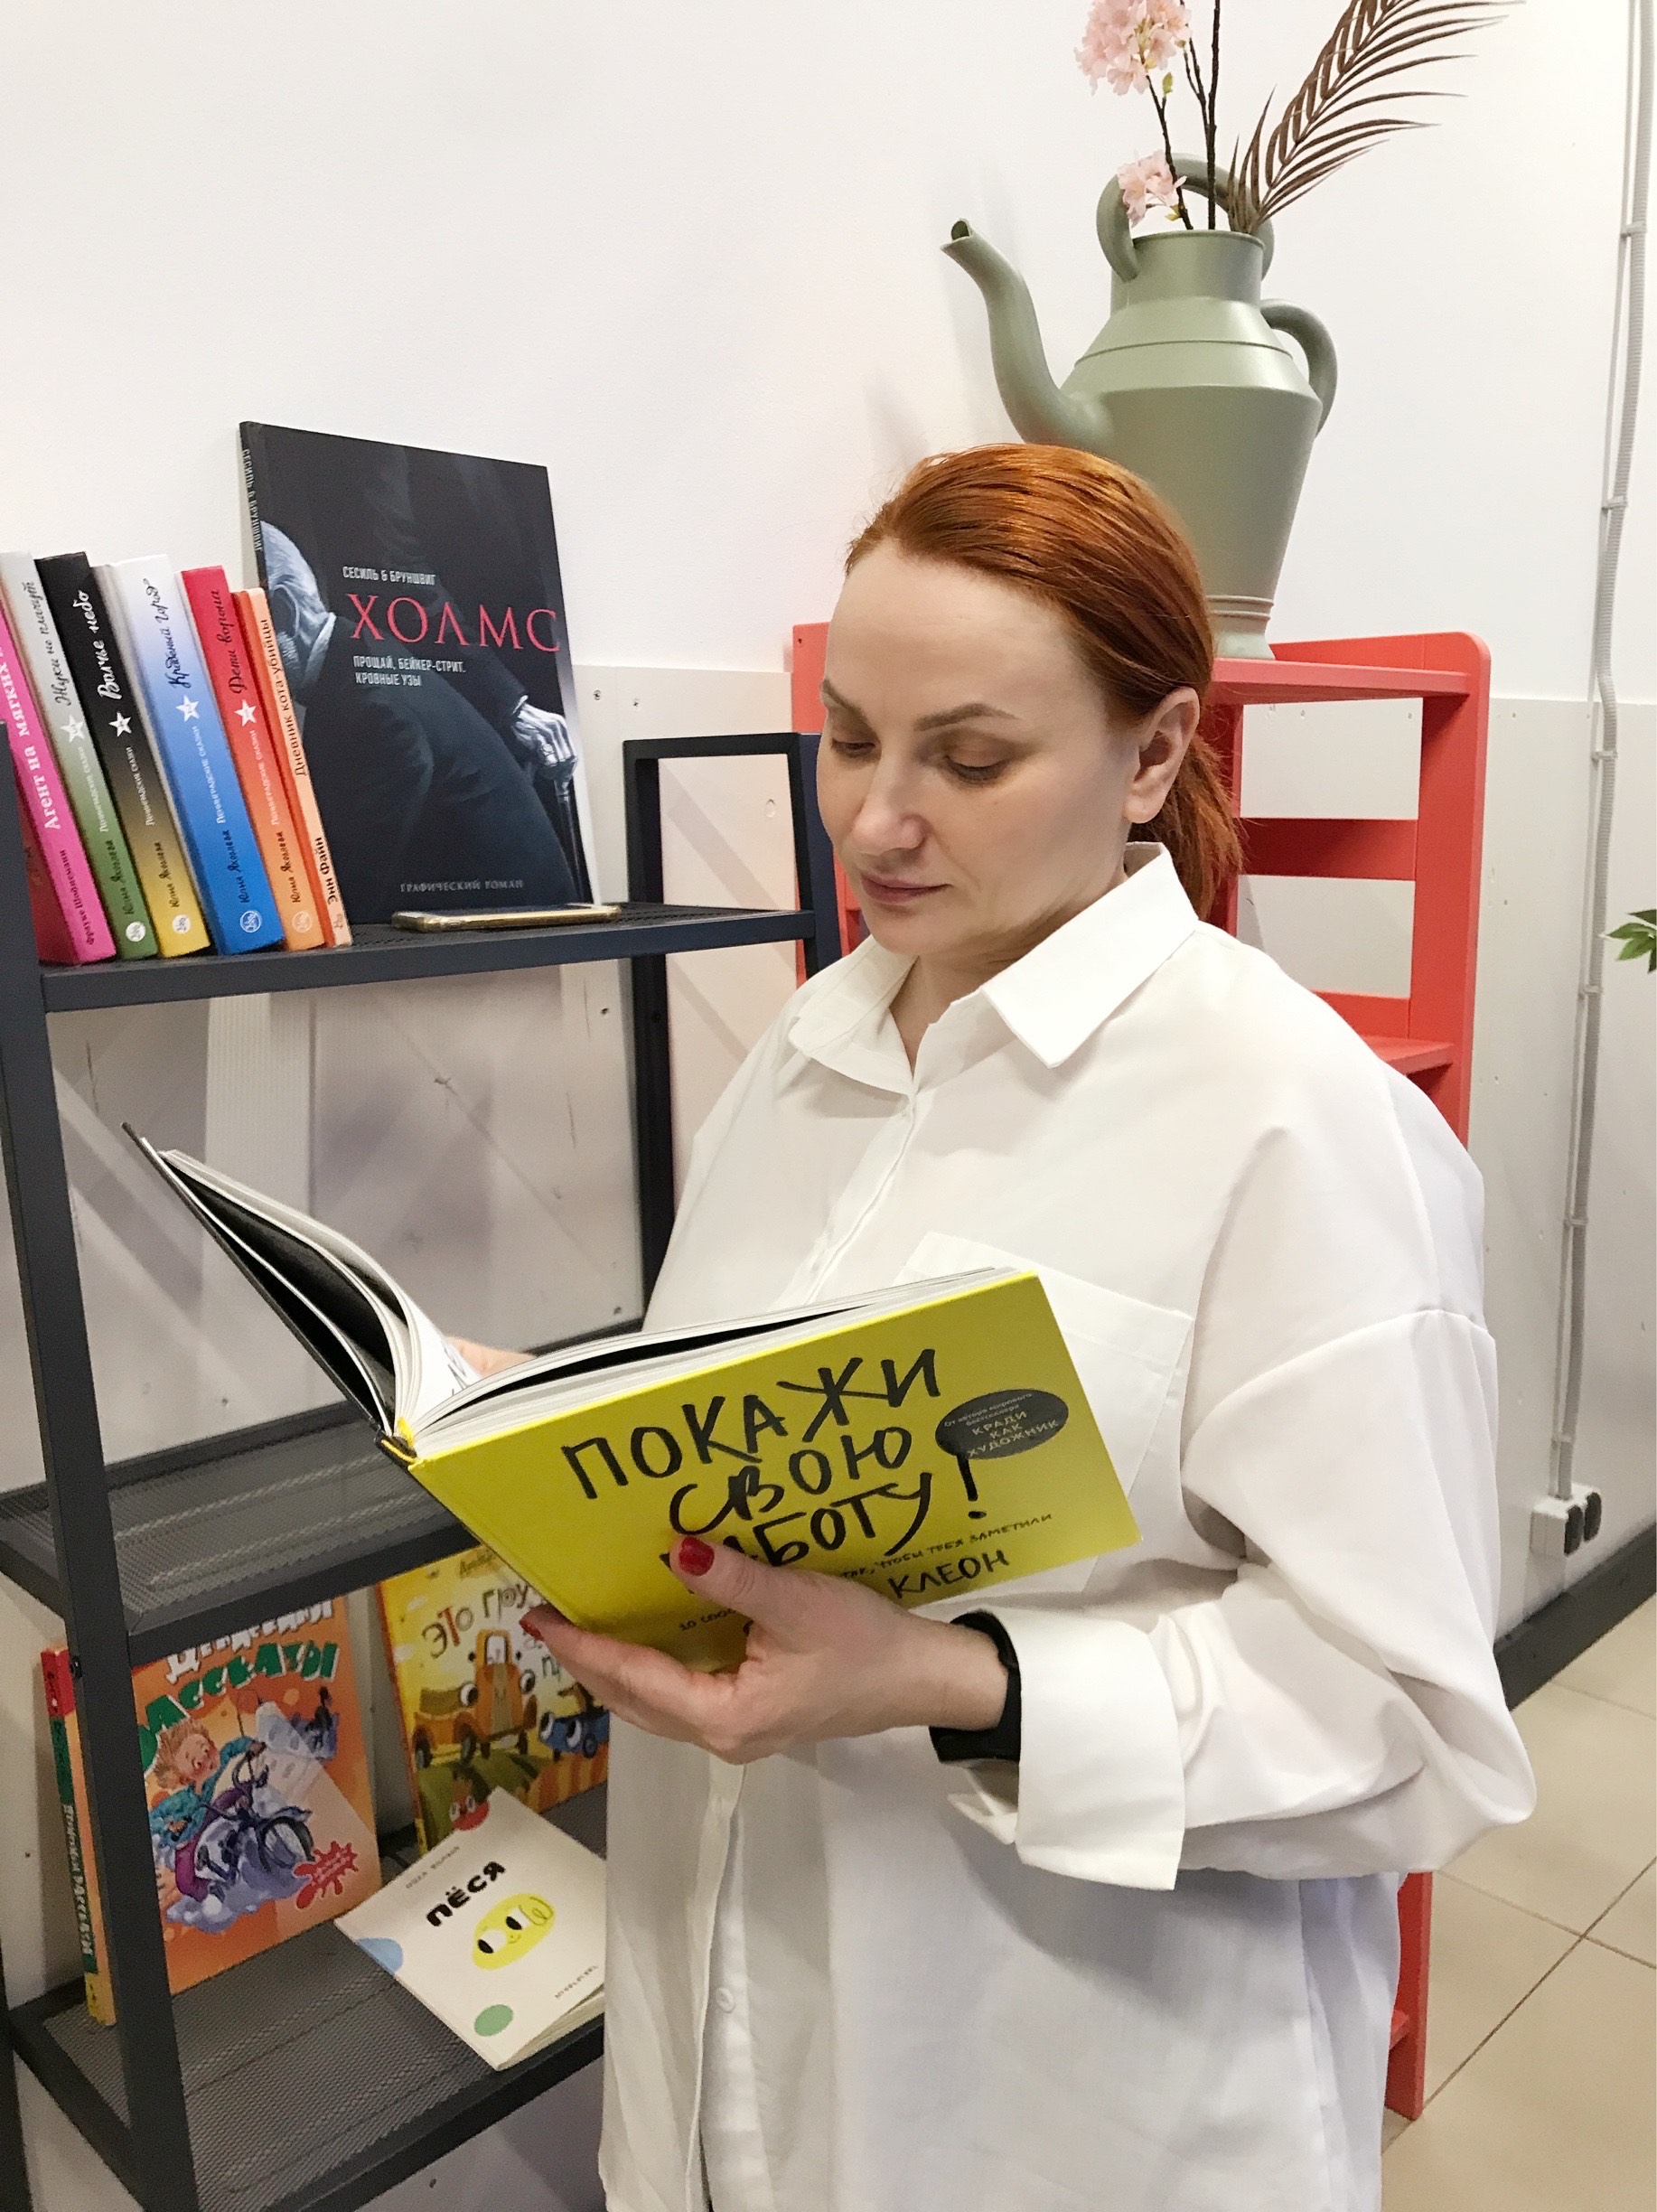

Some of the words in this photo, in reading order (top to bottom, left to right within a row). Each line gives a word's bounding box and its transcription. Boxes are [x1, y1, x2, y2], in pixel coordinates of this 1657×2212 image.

[342, 566, 379, 581] СЕСИЛЬ
[389, 571, 436, 586] БРУНШВИГ
[22, 581, 49, 634] плачут
[72, 590, 99, 633] небо
[211, 589, 234, 643] ворона
[346, 593, 561, 652] ХОЛМС
[45, 640, 54, 654] не
[260, 619, 291, 712] кота-убийцы
[353, 655, 397, 670] ПРОЩАЙ,
[398, 657, 467, 673] БЕЙКЕР-СТРИТ.
[51, 659, 71, 706] Жуки
[93, 640, 123, 700] Волчье
[229, 651, 248, 694] Дети
[355, 672, 399, 686] КРОВНЫЕ
[402, 674, 422, 687] УЗЫ
[0, 661, 30, 737] мягких
[24, 745, 41, 771] на
[281, 716, 307, 776] Дневник
[33, 774, 61, 830] Агент
[106, 840, 126, 883] Яковлева
[154, 842, 172, 880] Яковлева
[222, 830, 241, 874] Яковлева
[276, 831, 294, 874] Яковлева
[314, 837, 330, 875] Файн
[120, 887, 134, 914] Юлия
[166, 883, 180, 908] Юлия
[236, 876, 250, 904] Юлия
[288, 876, 301, 903] Юлия
[325, 877, 338, 905] Энн
[399, 878, 482, 893] ГРАФИЧЕСКИЙ
[484, 879, 524, 890] РОМАН
[562, 1348, 941, 1499] ПОКАЖИ
[967, 1419, 1060, 1457] ХУДОЖНИК
[971, 1411, 1027, 1436] КРАДИ
[989, 1423, 1023, 1439] КАК
[669, 1427, 913, 1535] СВОЮ
[926, 1539, 965, 1555] ТЕБЯ
[969, 1513, 1053, 1544] ЗАМЕТИЛИ
[888, 1549, 1010, 1598] КЛЕОН
[426, 1861, 507, 1927] ПЁСЯ
